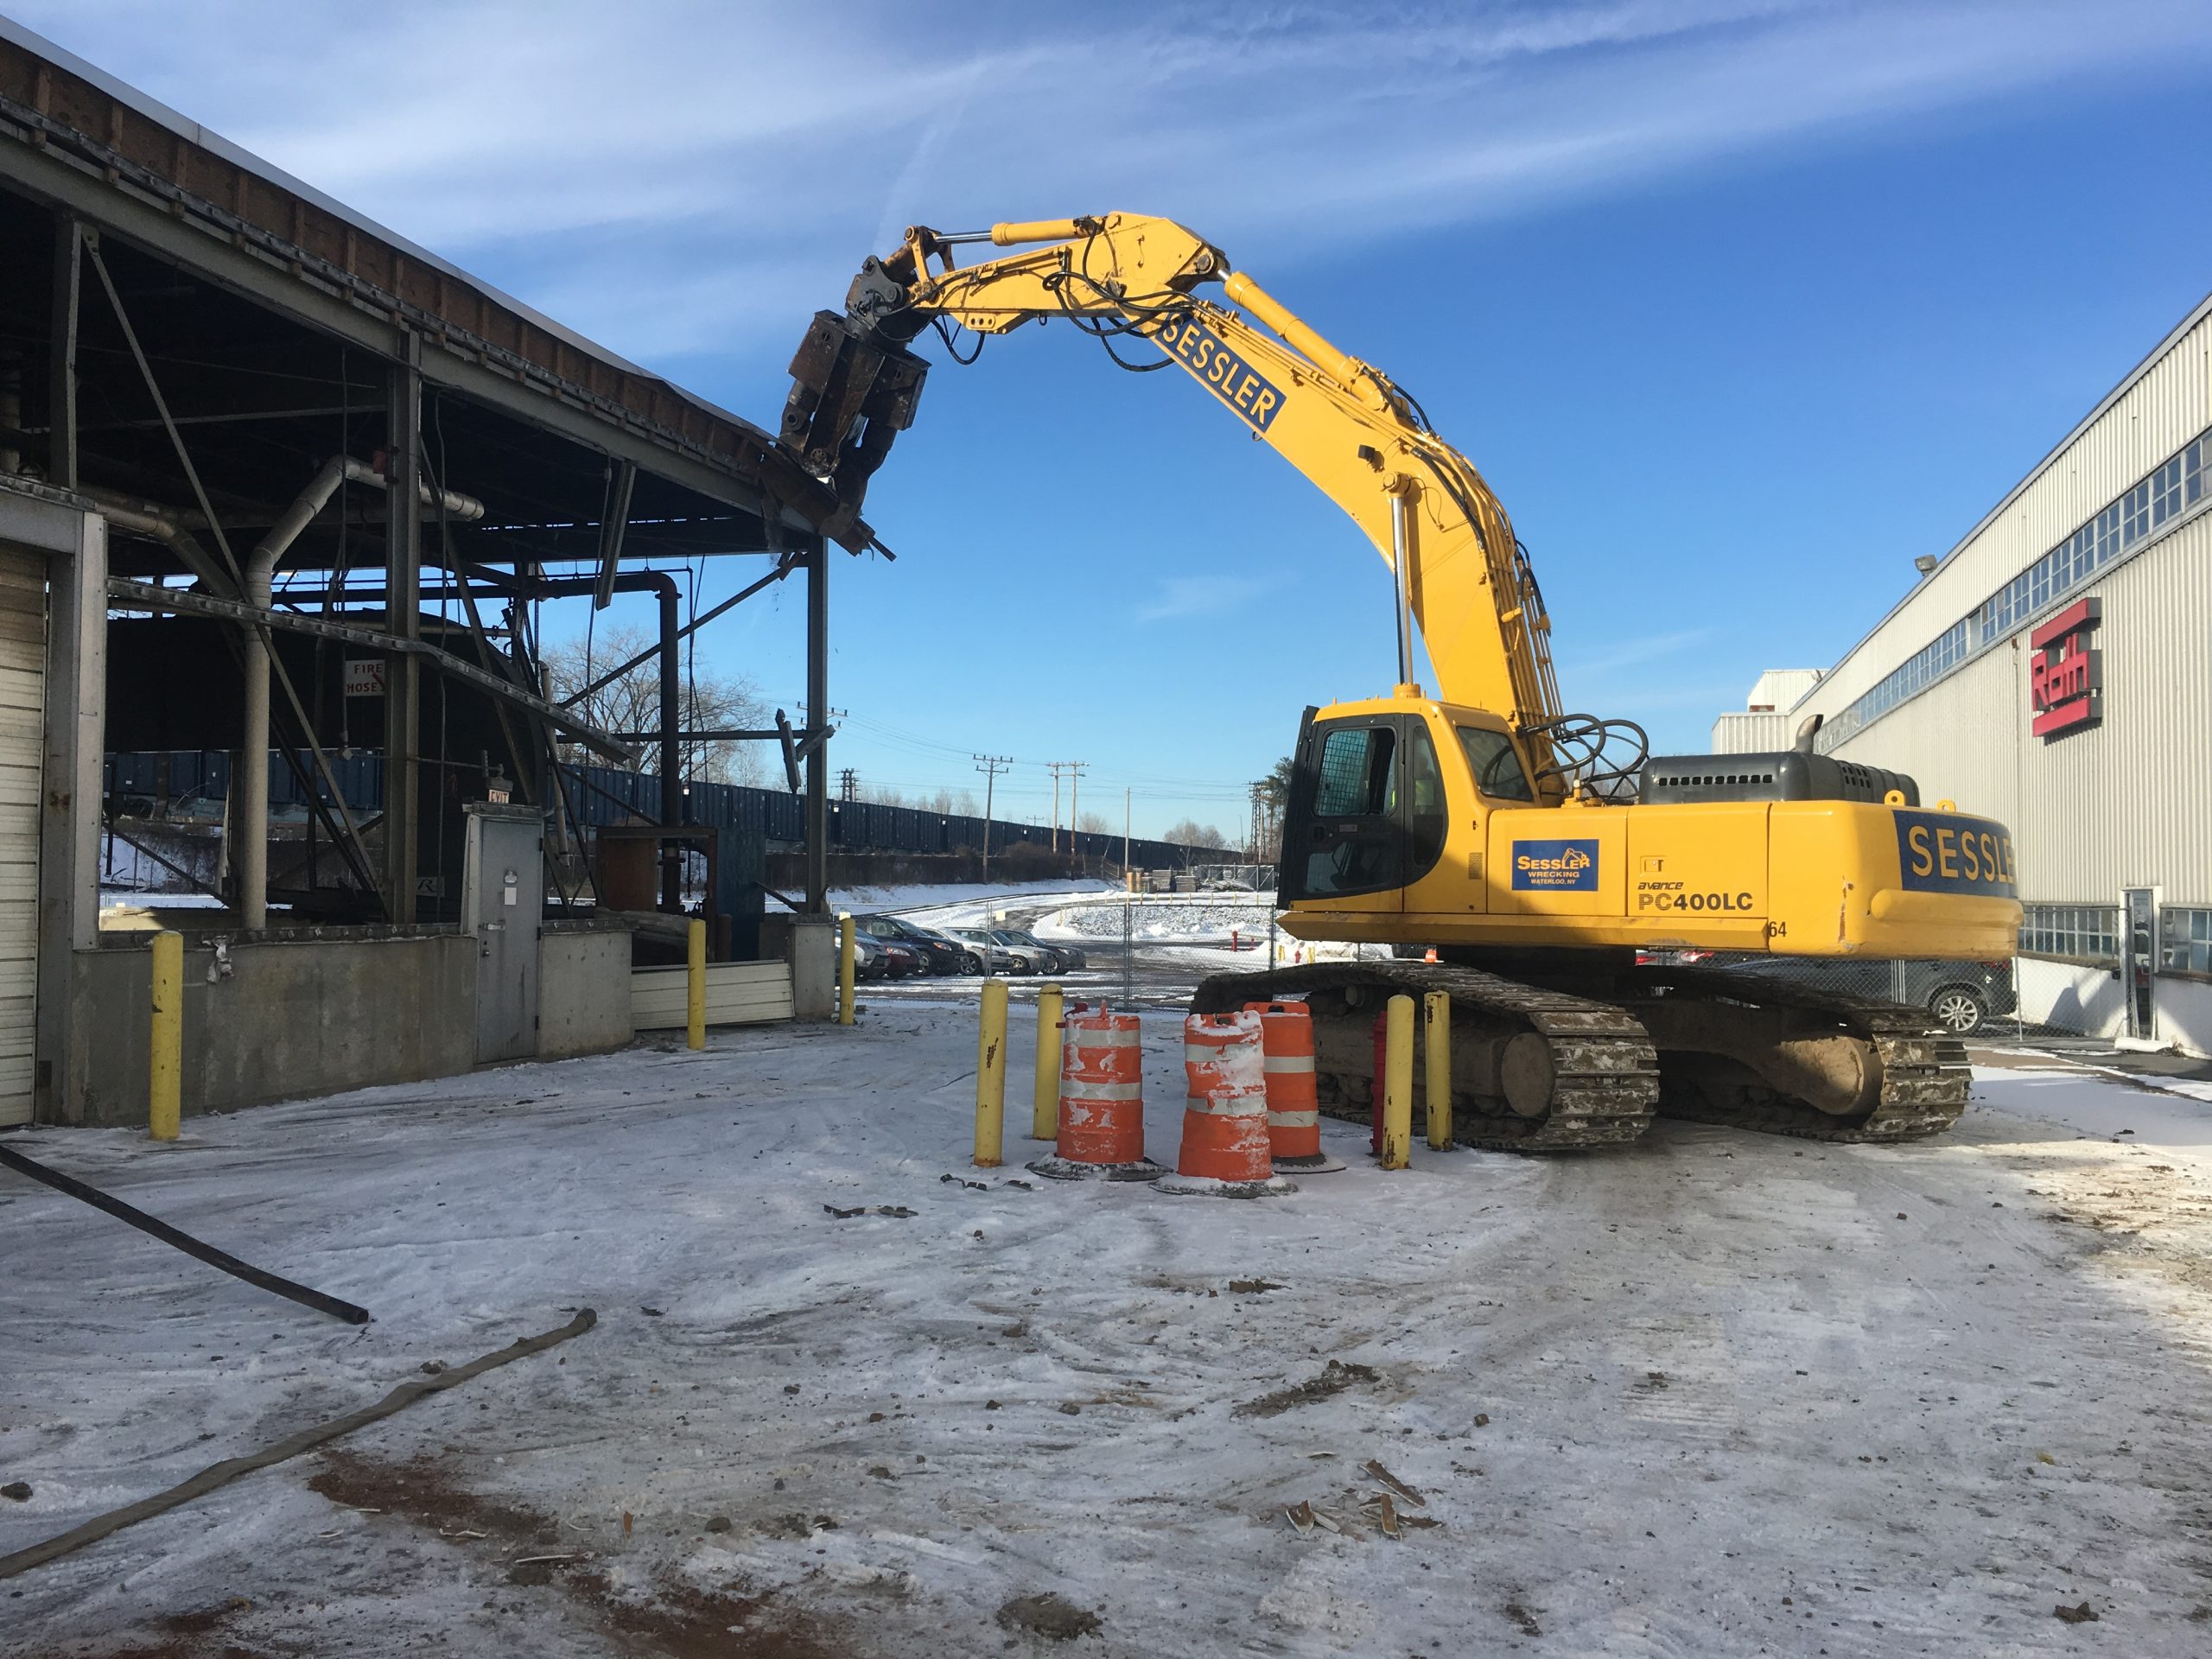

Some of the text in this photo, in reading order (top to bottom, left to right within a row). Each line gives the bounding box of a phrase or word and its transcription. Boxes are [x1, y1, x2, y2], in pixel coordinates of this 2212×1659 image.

[1162, 312, 1276, 424] SESSLER
[354, 664, 383, 673] FIRE
[346, 683, 378, 693] HOSE
[1517, 855, 1590, 870] SESSLER
[1909, 825, 2015, 884] SESSLE
[1638, 881, 1683, 890] avance
[1638, 893, 1753, 911] PC400LC
[1769, 921, 1787, 938] 64
